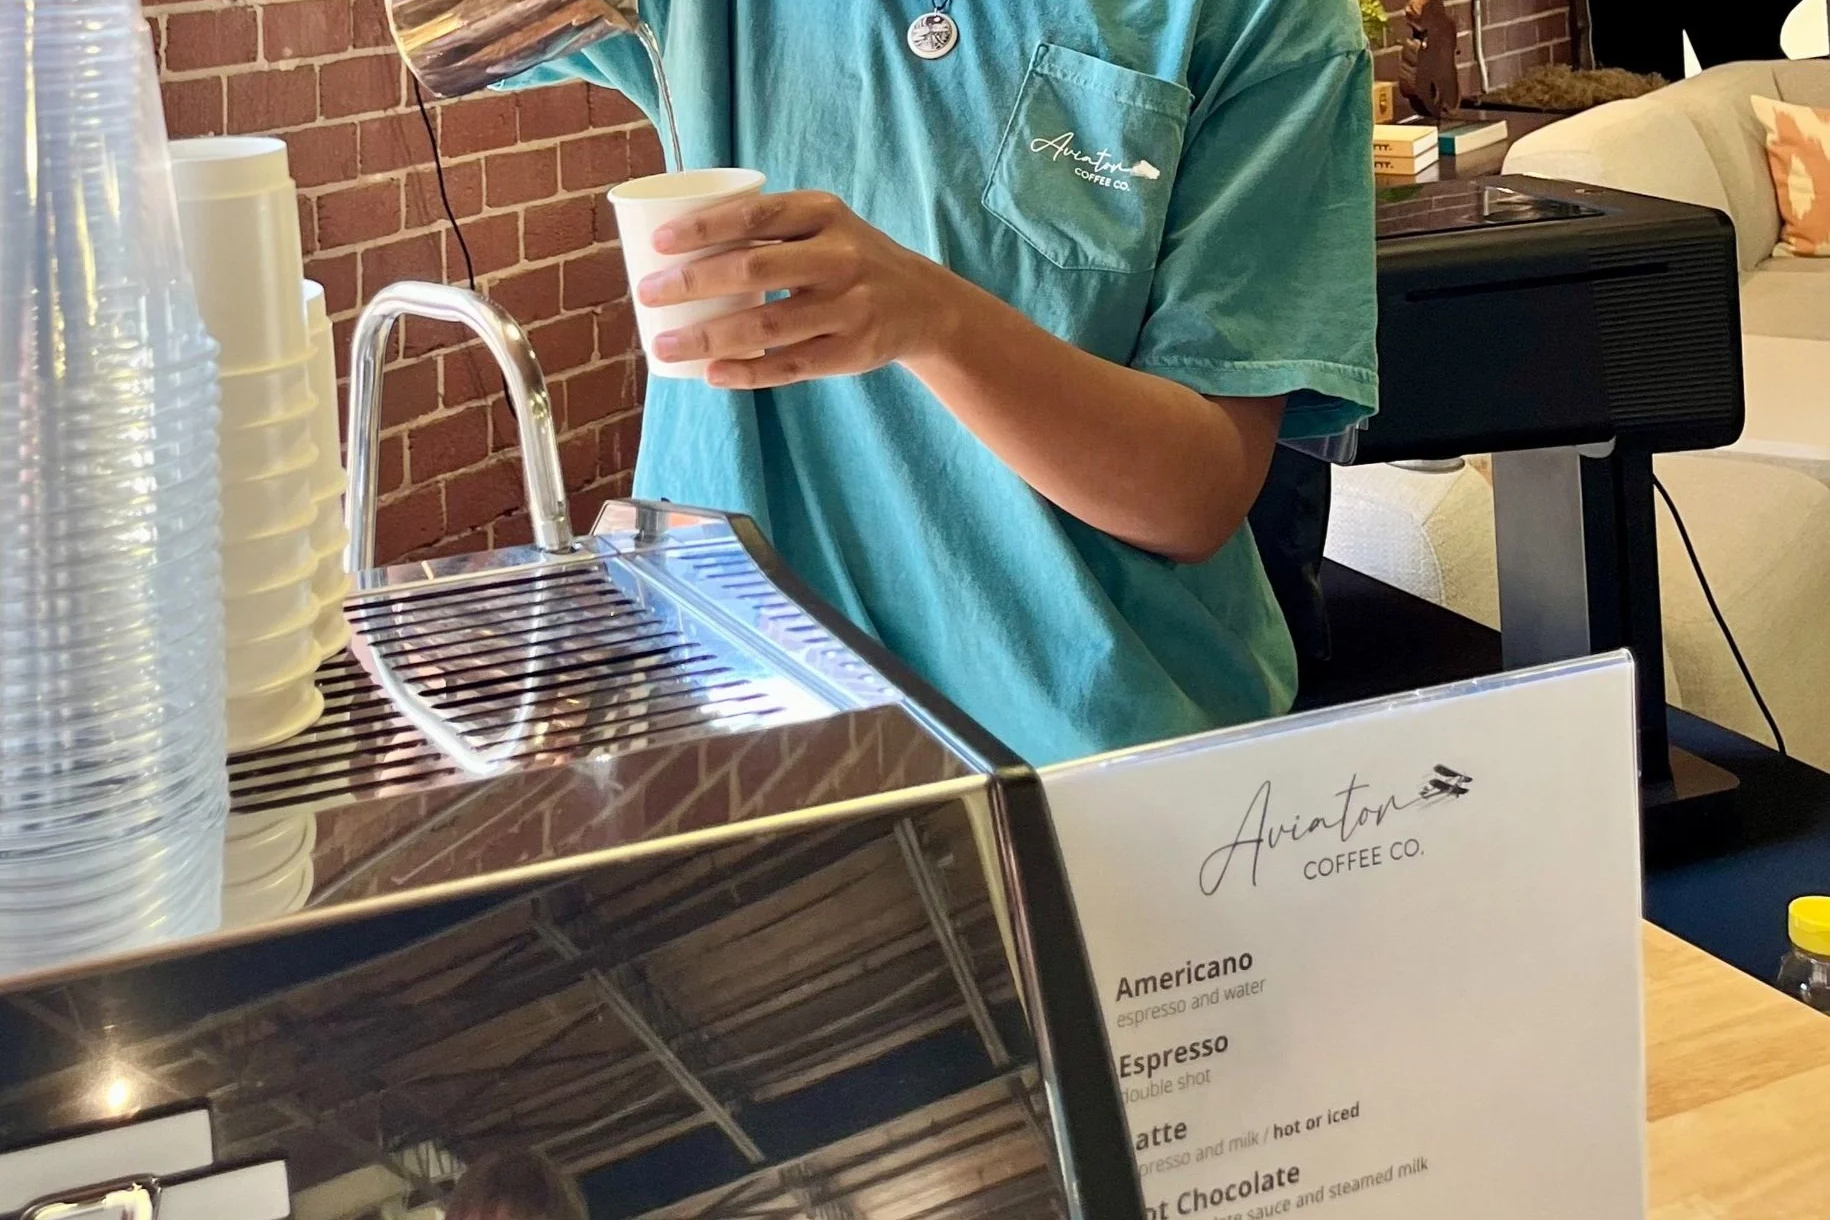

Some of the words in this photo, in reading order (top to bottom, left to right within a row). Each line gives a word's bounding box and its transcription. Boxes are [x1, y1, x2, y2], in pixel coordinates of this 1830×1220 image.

[1030, 131, 1131, 174] Aviator
[1074, 167, 1112, 187] COFFEE
[1113, 179, 1131, 192] CO.
[1199, 773, 1422, 896] Aviator
[1303, 846, 1382, 880] COFFEE
[1389, 838, 1425, 861] CO.
[1115, 952, 1254, 1002] Americano
[1116, 999, 1187, 1028] espresso
[1191, 988, 1220, 1010] and
[1224, 978, 1267, 1001] water
[1119, 1035, 1229, 1079] Espresso
[1178, 1068, 1211, 1090] shot
[1135, 1121, 1188, 1151] atte
[1138, 1152, 1192, 1177] presso
[1195, 1140, 1225, 1162] and
[1229, 1130, 1260, 1153] milk
[1273, 1120, 1301, 1140] hot
[1305, 1115, 1323, 1131] or
[1327, 1101, 1361, 1125] iced
[1177, 1166, 1301, 1216] Chocolate
[1247, 1198, 1291, 1220] sauce
[1296, 1186, 1325, 1208] and
[1328, 1165, 1394, 1199] steamed
[1397, 1156, 1429, 1179] milk
